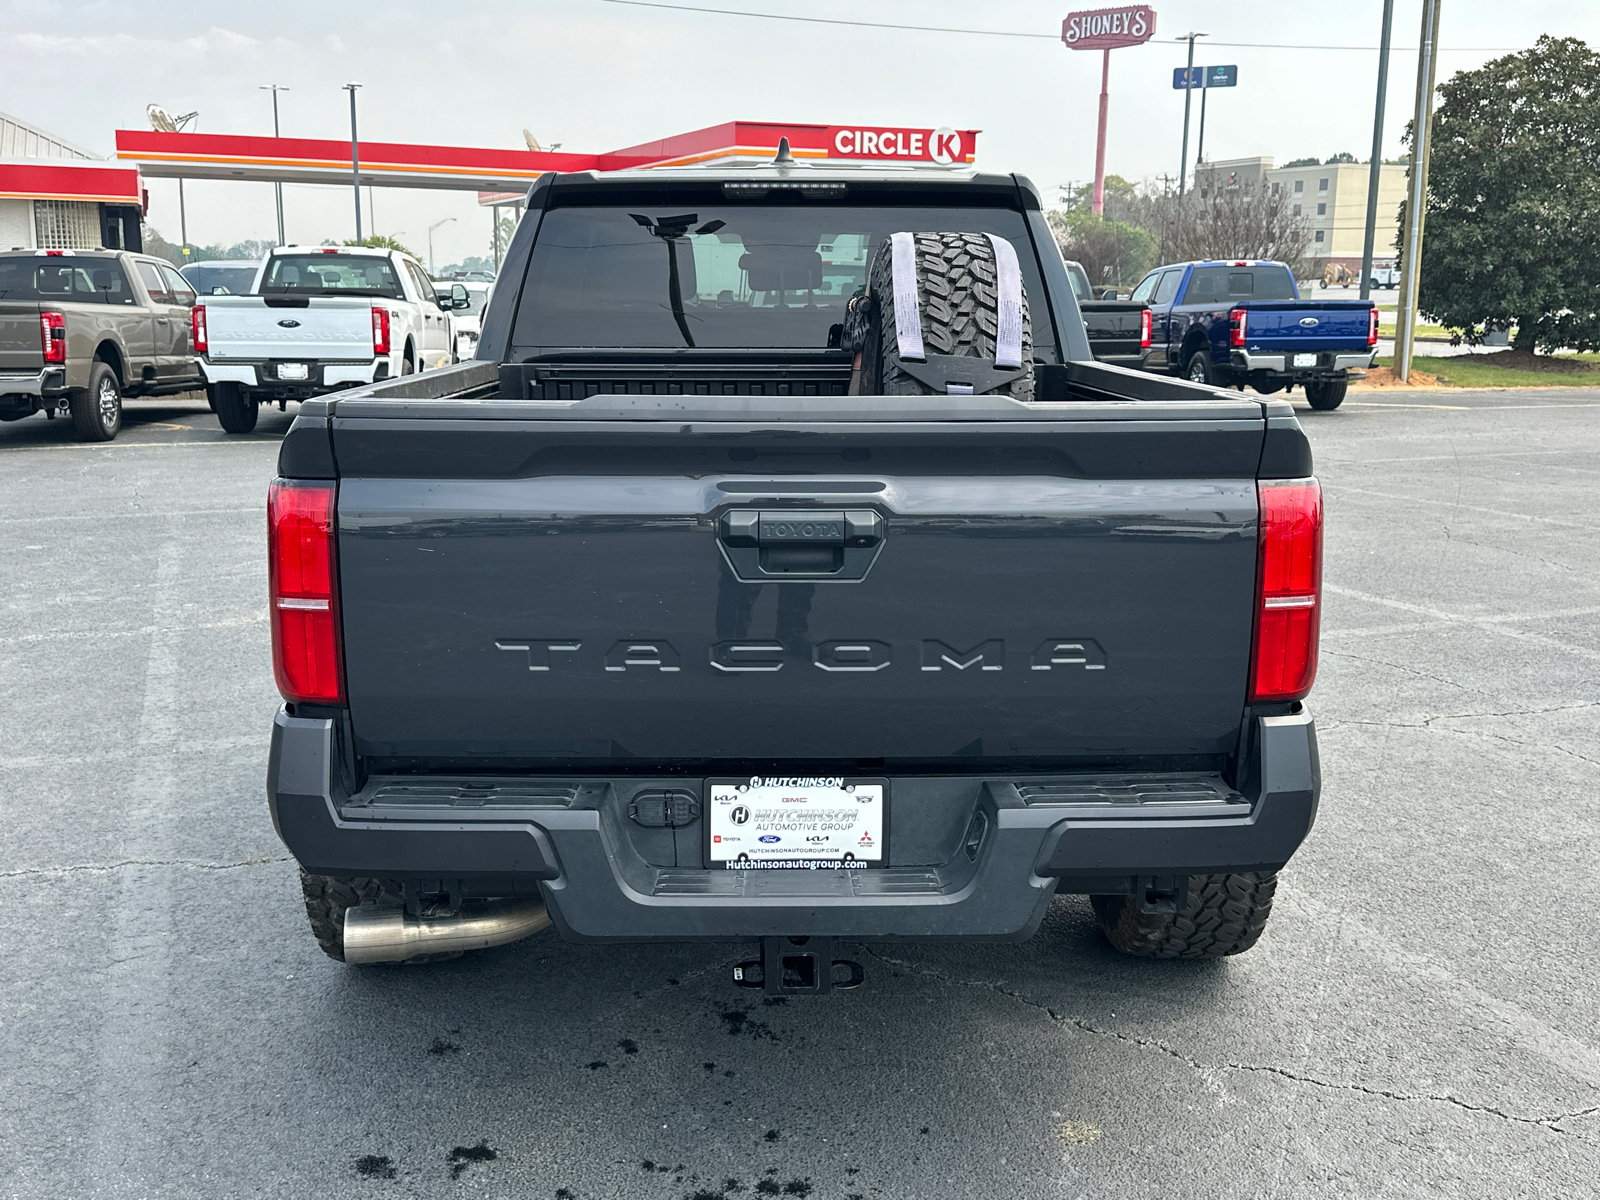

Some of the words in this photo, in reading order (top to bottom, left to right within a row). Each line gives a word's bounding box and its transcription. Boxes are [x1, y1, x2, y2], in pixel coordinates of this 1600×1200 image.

[1066, 9, 1146, 42] SHONEY'S
[834, 130, 923, 156] CIRCLE
[935, 131, 961, 163] K
[763, 522, 841, 537] TOYOTA
[494, 638, 1107, 671] TACOMA
[763, 777, 844, 788] HUTCHINSON
[753, 809, 859, 822] HUTCHINSON
[755, 823, 818, 831] AUTOMOTIVE
[820, 823, 854, 831] GROUP
[726, 860, 867, 870] Hutchinsonautogroup.com
